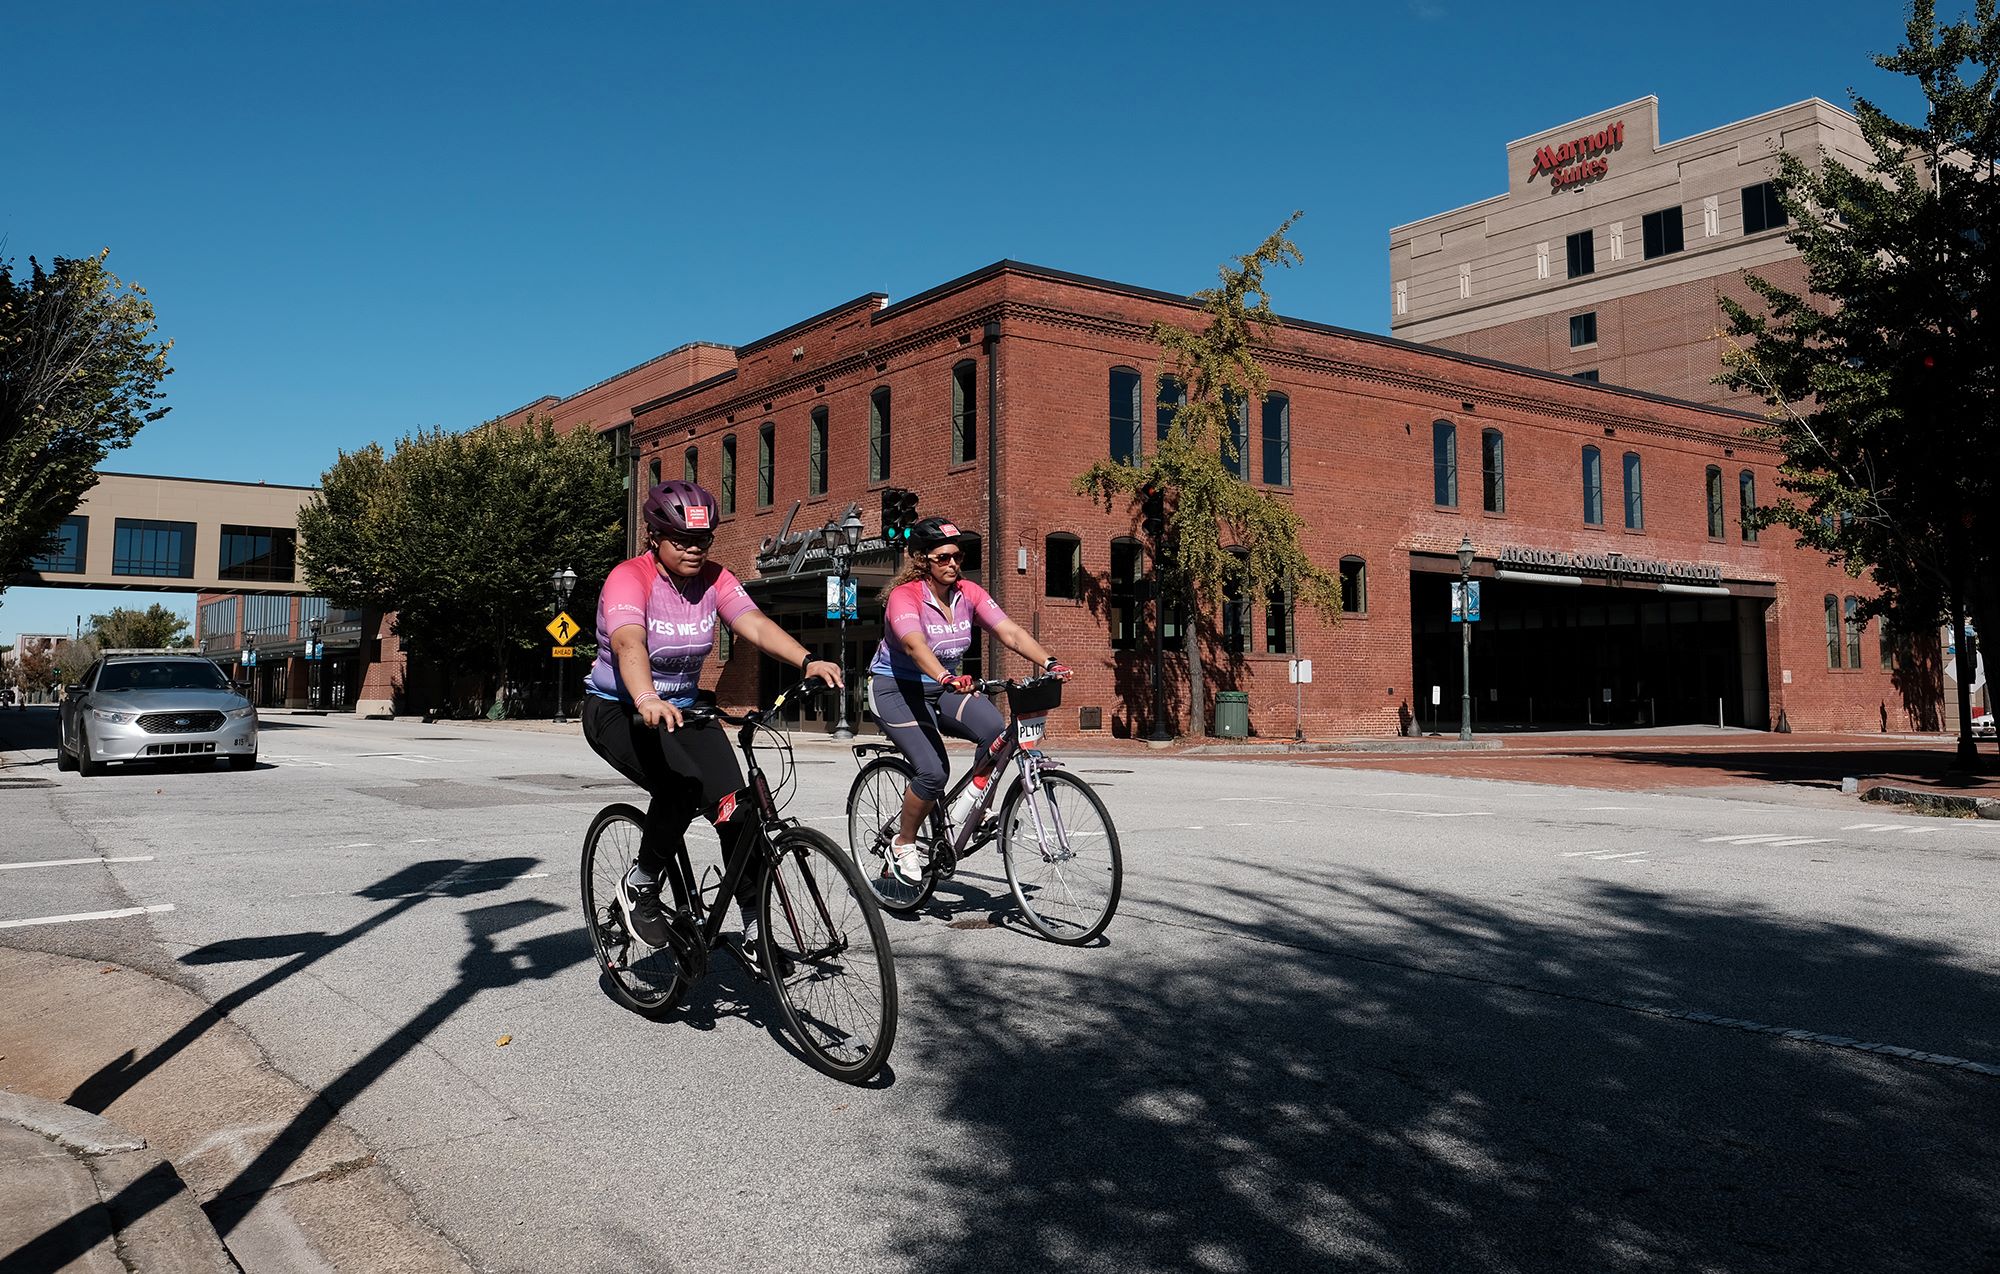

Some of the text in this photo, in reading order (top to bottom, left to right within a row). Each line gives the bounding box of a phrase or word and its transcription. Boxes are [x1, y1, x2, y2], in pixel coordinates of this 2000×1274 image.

[1529, 120, 1625, 178] Marriott
[1551, 156, 1609, 188] Suites
[1499, 544, 1570, 568] AUGUSTA
[648, 617, 675, 636] YES
[676, 622, 699, 636] WE
[925, 623, 944, 635] YES
